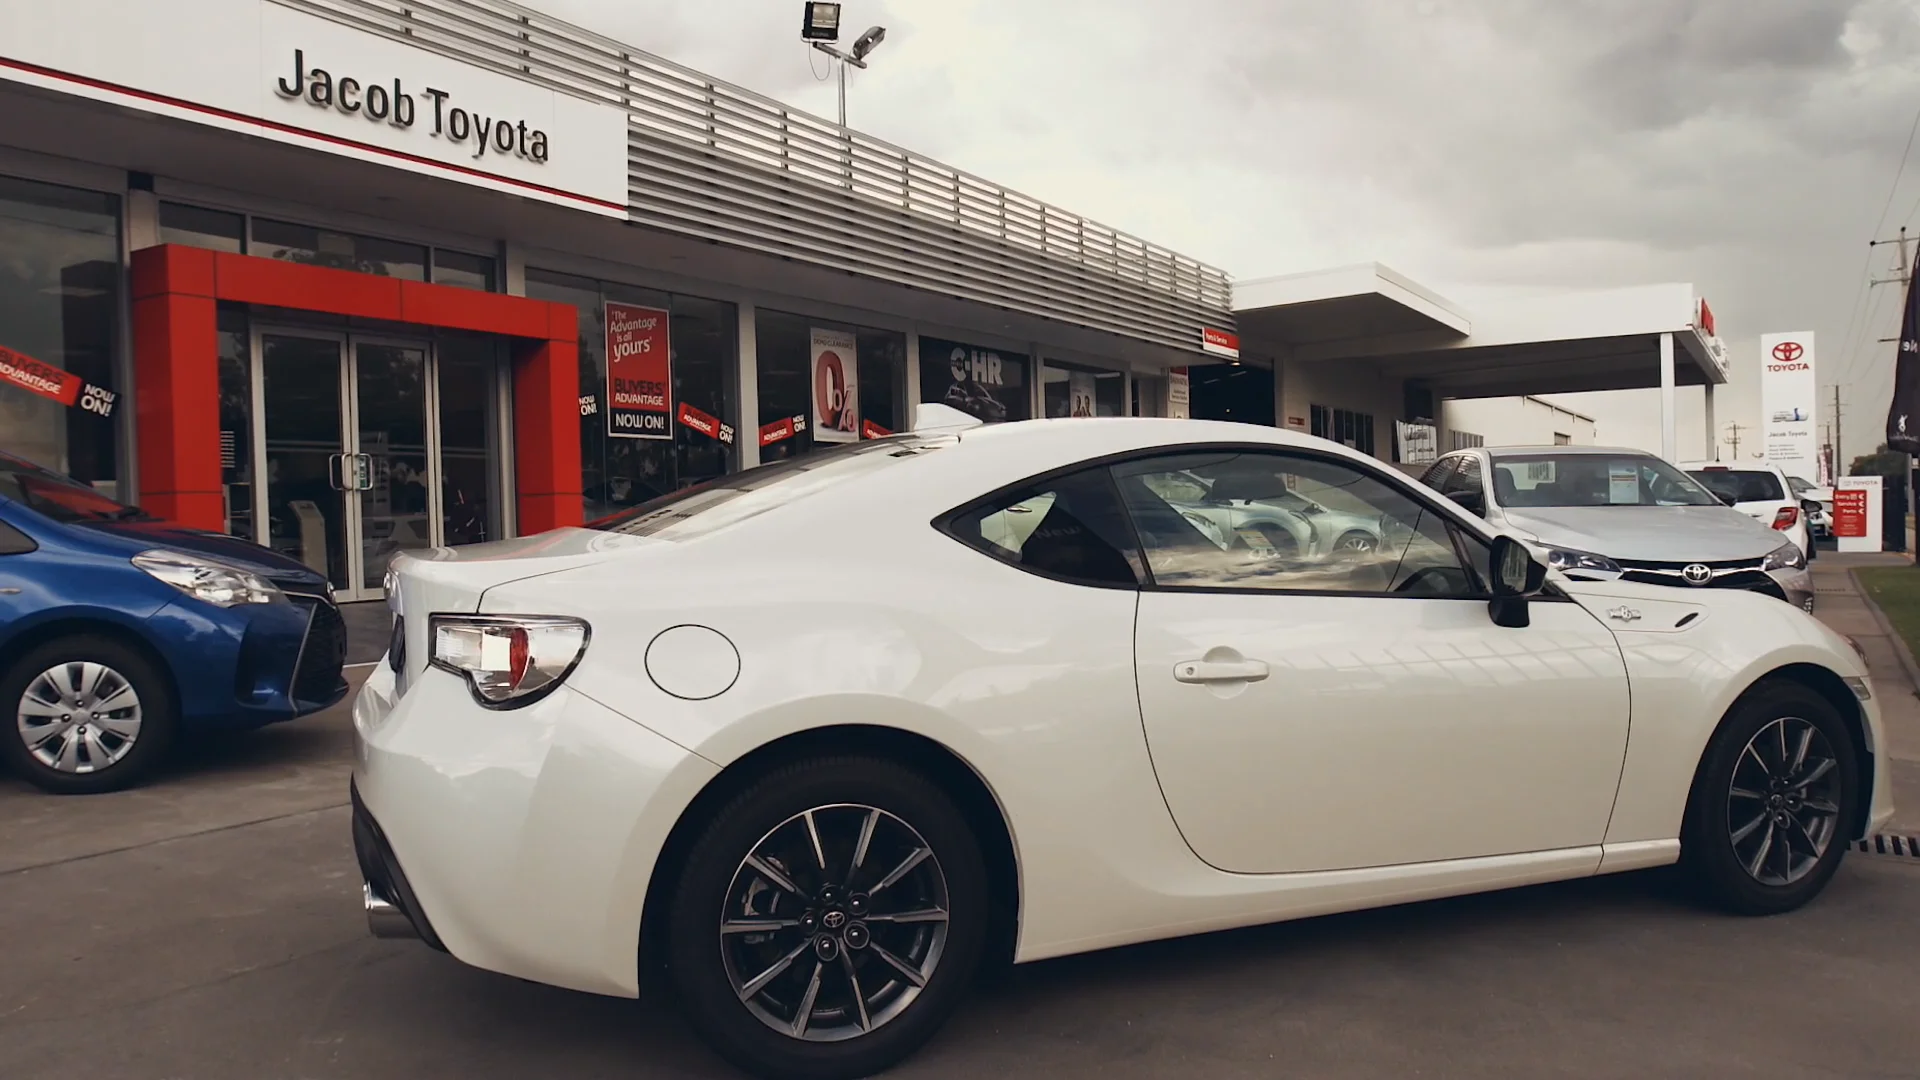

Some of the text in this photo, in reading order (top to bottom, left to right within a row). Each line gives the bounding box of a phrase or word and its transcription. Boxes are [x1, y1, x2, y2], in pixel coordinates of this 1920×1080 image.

[276, 49, 548, 162] Jacob Toyota
[610, 317, 657, 333] Advantage
[616, 331, 633, 342] is all
[950, 347, 1004, 385] C-HR
[1767, 362, 1809, 372] TOYOTA
[84, 383, 115, 403] NOW
[615, 393, 664, 406] ADVANTAGE
[80, 395, 112, 417] ON!
[580, 403, 597, 416] ON!
[616, 413, 665, 429] NOW ON!
